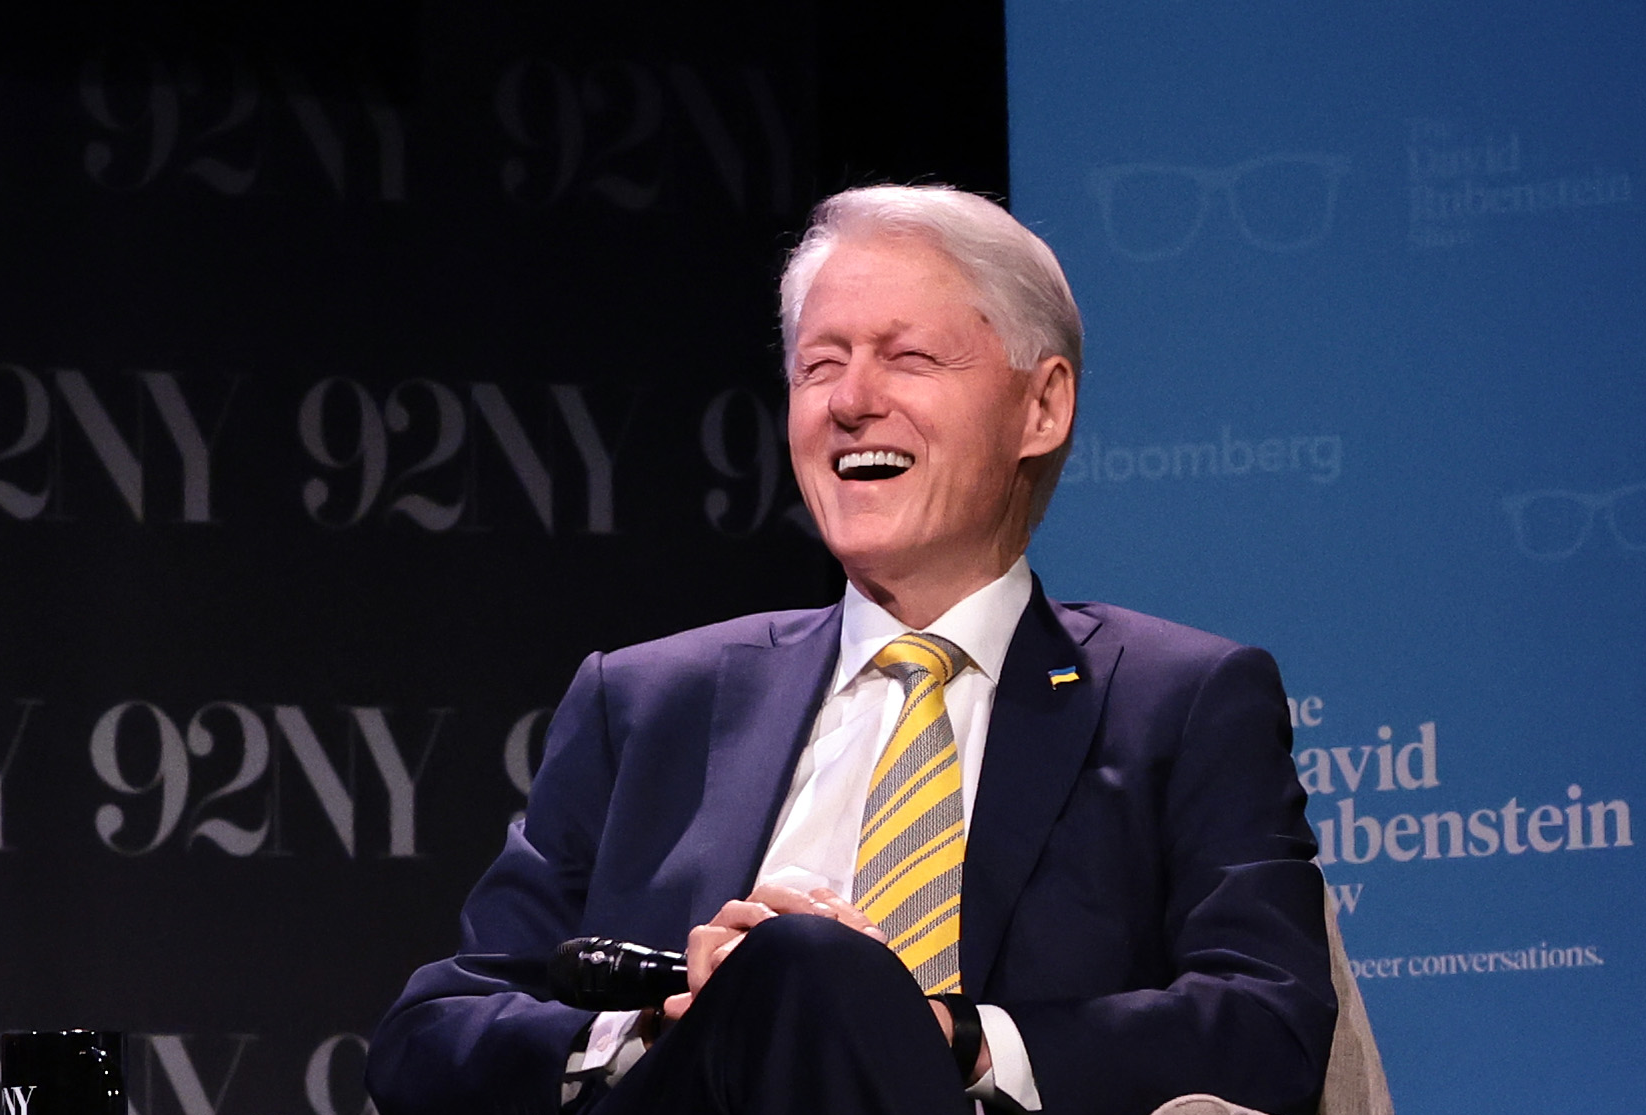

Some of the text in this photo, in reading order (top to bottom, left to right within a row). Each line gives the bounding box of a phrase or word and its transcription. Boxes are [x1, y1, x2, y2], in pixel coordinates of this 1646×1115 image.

[297, 376, 646, 536] 92NY
[89, 701, 453, 858] 92NY
[1297, 722, 1441, 795] avid
[1408, 941, 1604, 977] conversations.
